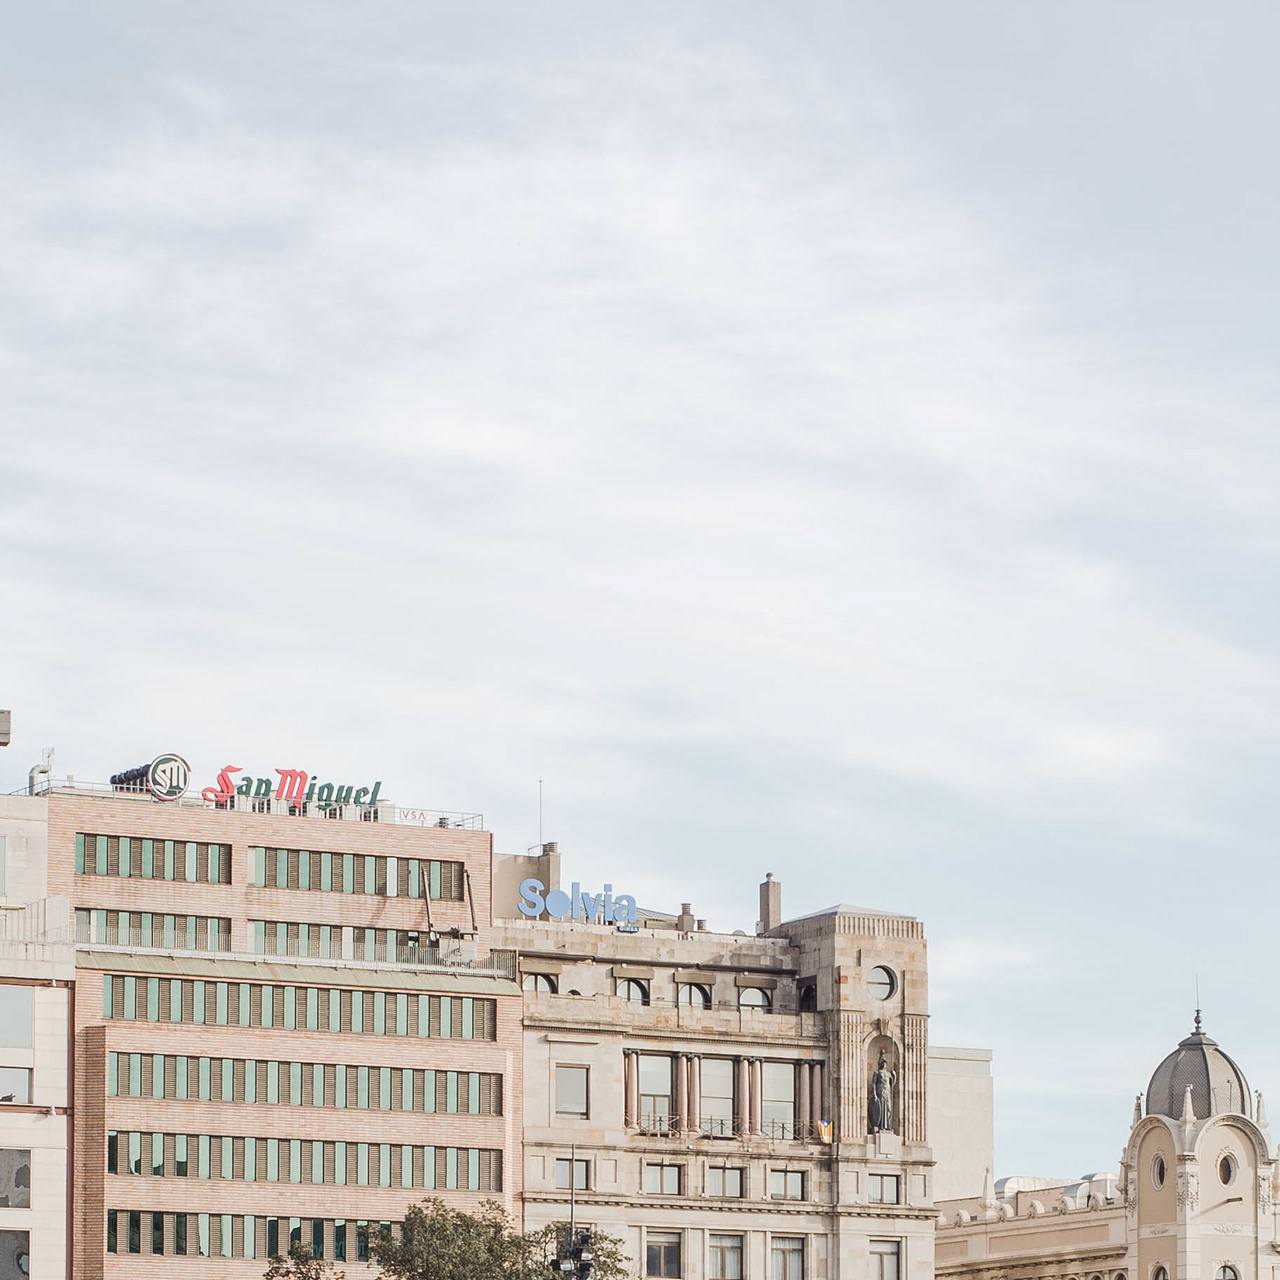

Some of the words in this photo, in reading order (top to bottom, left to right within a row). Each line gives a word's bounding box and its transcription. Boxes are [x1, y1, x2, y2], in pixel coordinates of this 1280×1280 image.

[201, 765, 272, 803] San
[275, 768, 381, 810] Miguel
[517, 878, 636, 923] Solvia
